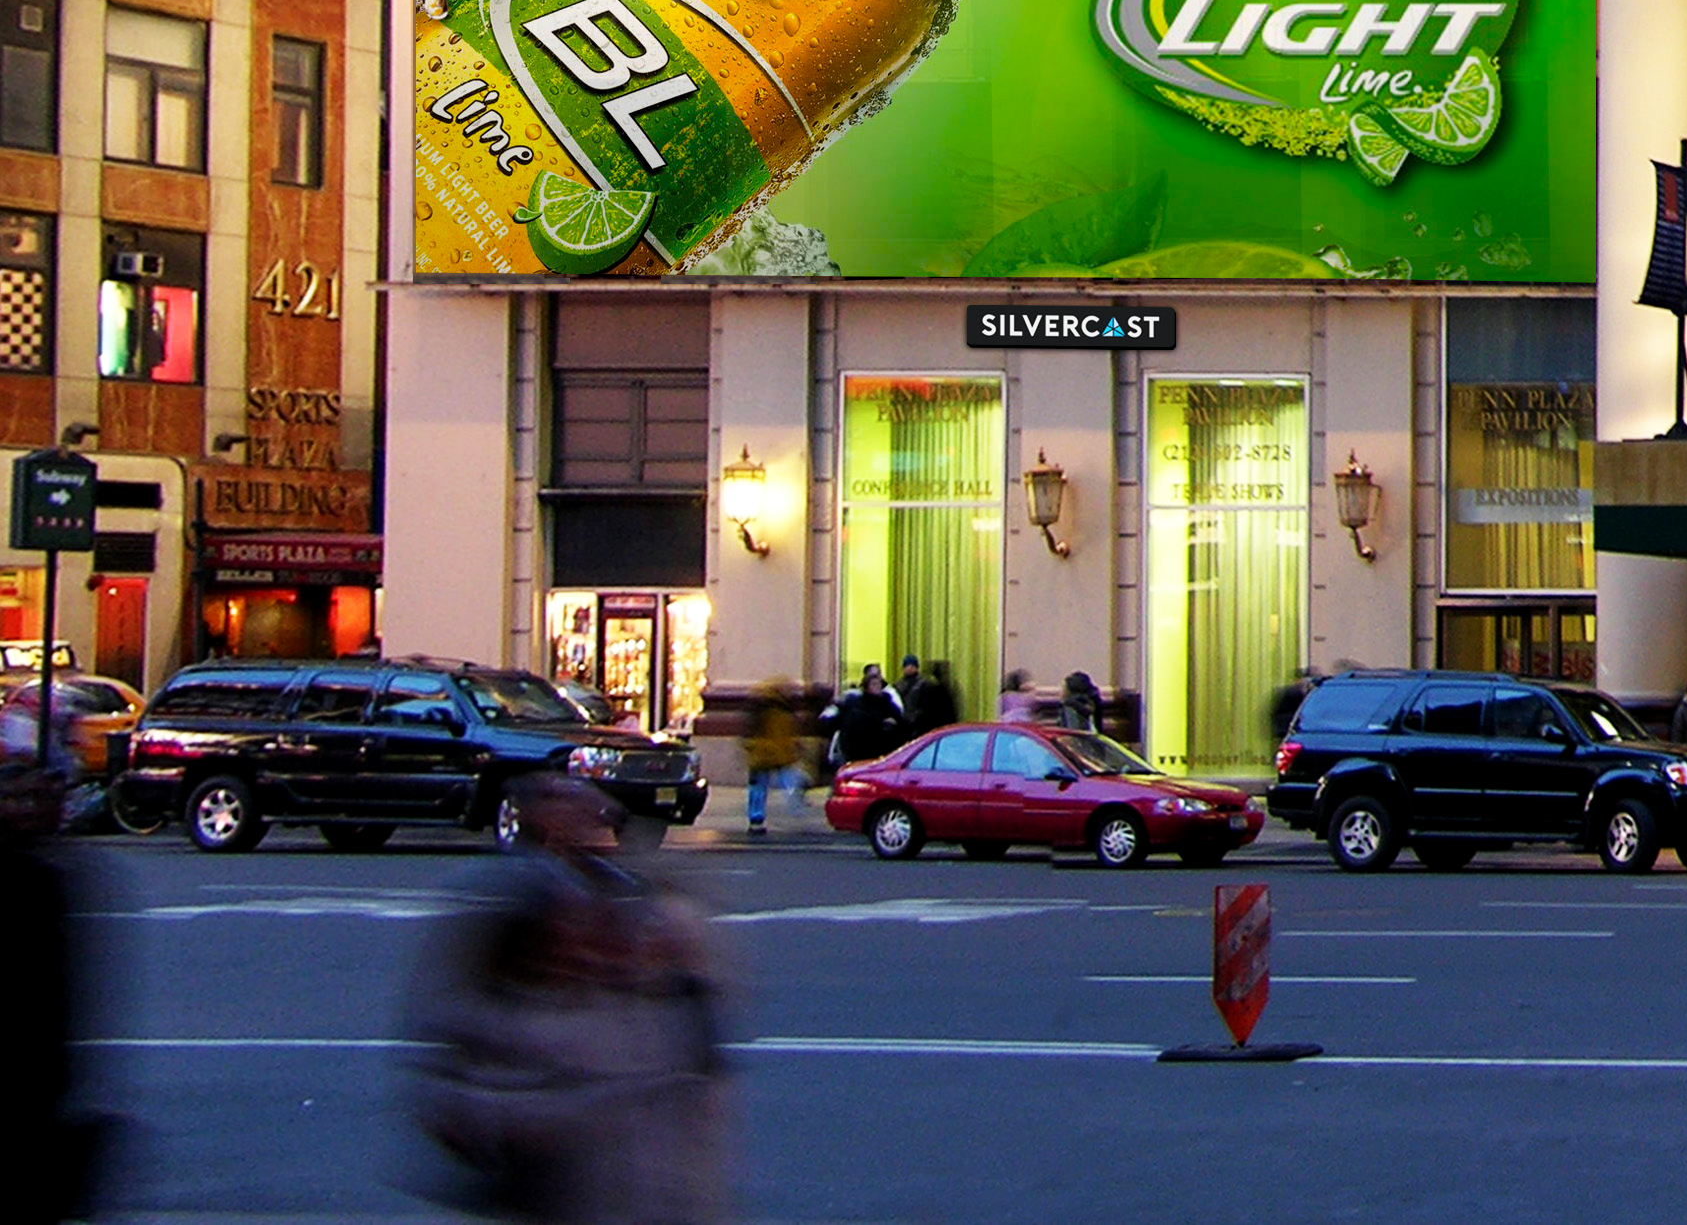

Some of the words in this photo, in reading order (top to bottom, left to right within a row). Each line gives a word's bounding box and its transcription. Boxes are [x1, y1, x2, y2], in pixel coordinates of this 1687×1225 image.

[430, 77, 535, 177] Lime
[440, 162, 480, 203] LIGHT
[475, 200, 510, 240] BEER
[436, 188, 490, 251] NATURAL
[486, 247, 517, 274] LIM
[252, 258, 341, 321] 421
[249, 387, 341, 425] SPORTS
[1527, 389, 1595, 409] PLAZA
[1480, 411, 1573, 430] PAVILION
[251, 436, 338, 471] PLAZA
[214, 479, 348, 517] BUILDING
[953, 480, 993, 497] HALL
[1231, 483, 1285, 501] SHOWS
[1475, 488, 1580, 507] EXPOSITIONS
[222, 543, 274, 562] SPORTS
[278, 544, 326, 562] PLAZA
